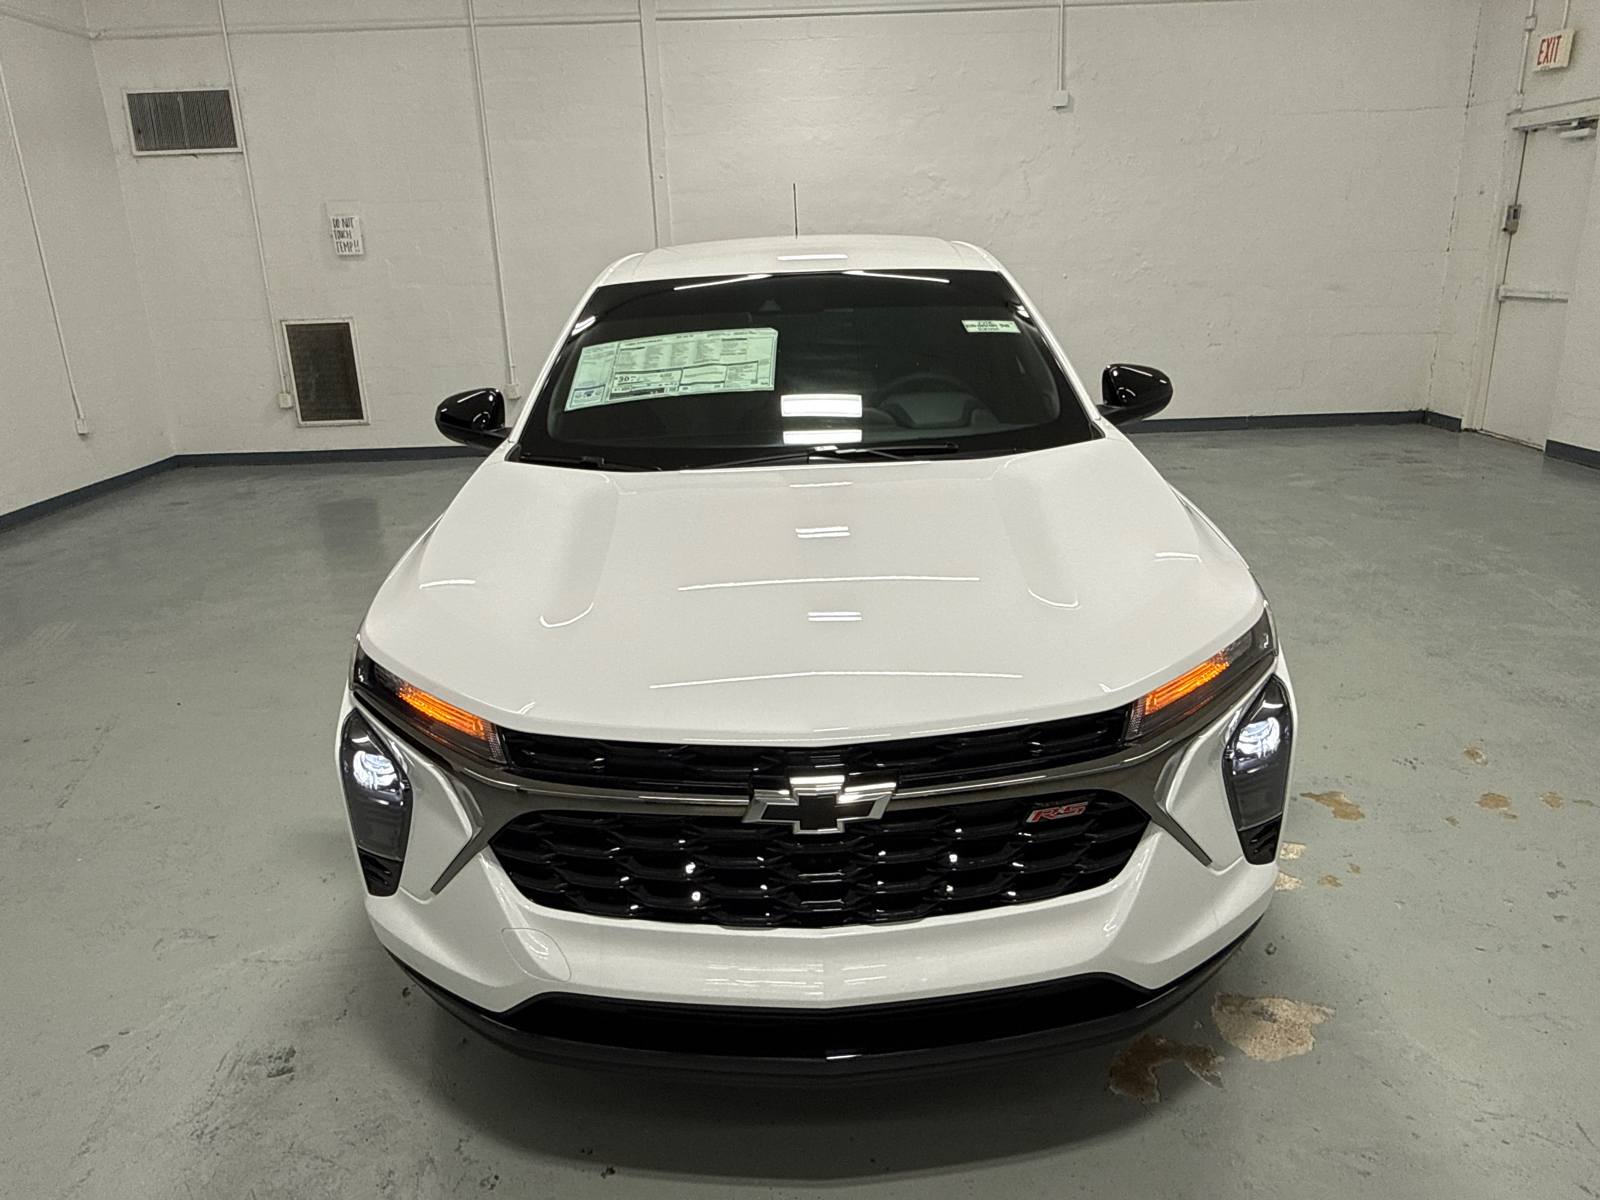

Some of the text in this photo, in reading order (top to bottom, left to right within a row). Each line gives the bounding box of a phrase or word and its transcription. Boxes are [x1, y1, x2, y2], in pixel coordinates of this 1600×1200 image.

[1537, 34, 1562, 66] EXIT
[341, 217, 355, 228] NOT
[333, 229, 352, 240] TOUCH
[1025, 801, 1089, 823] RS
